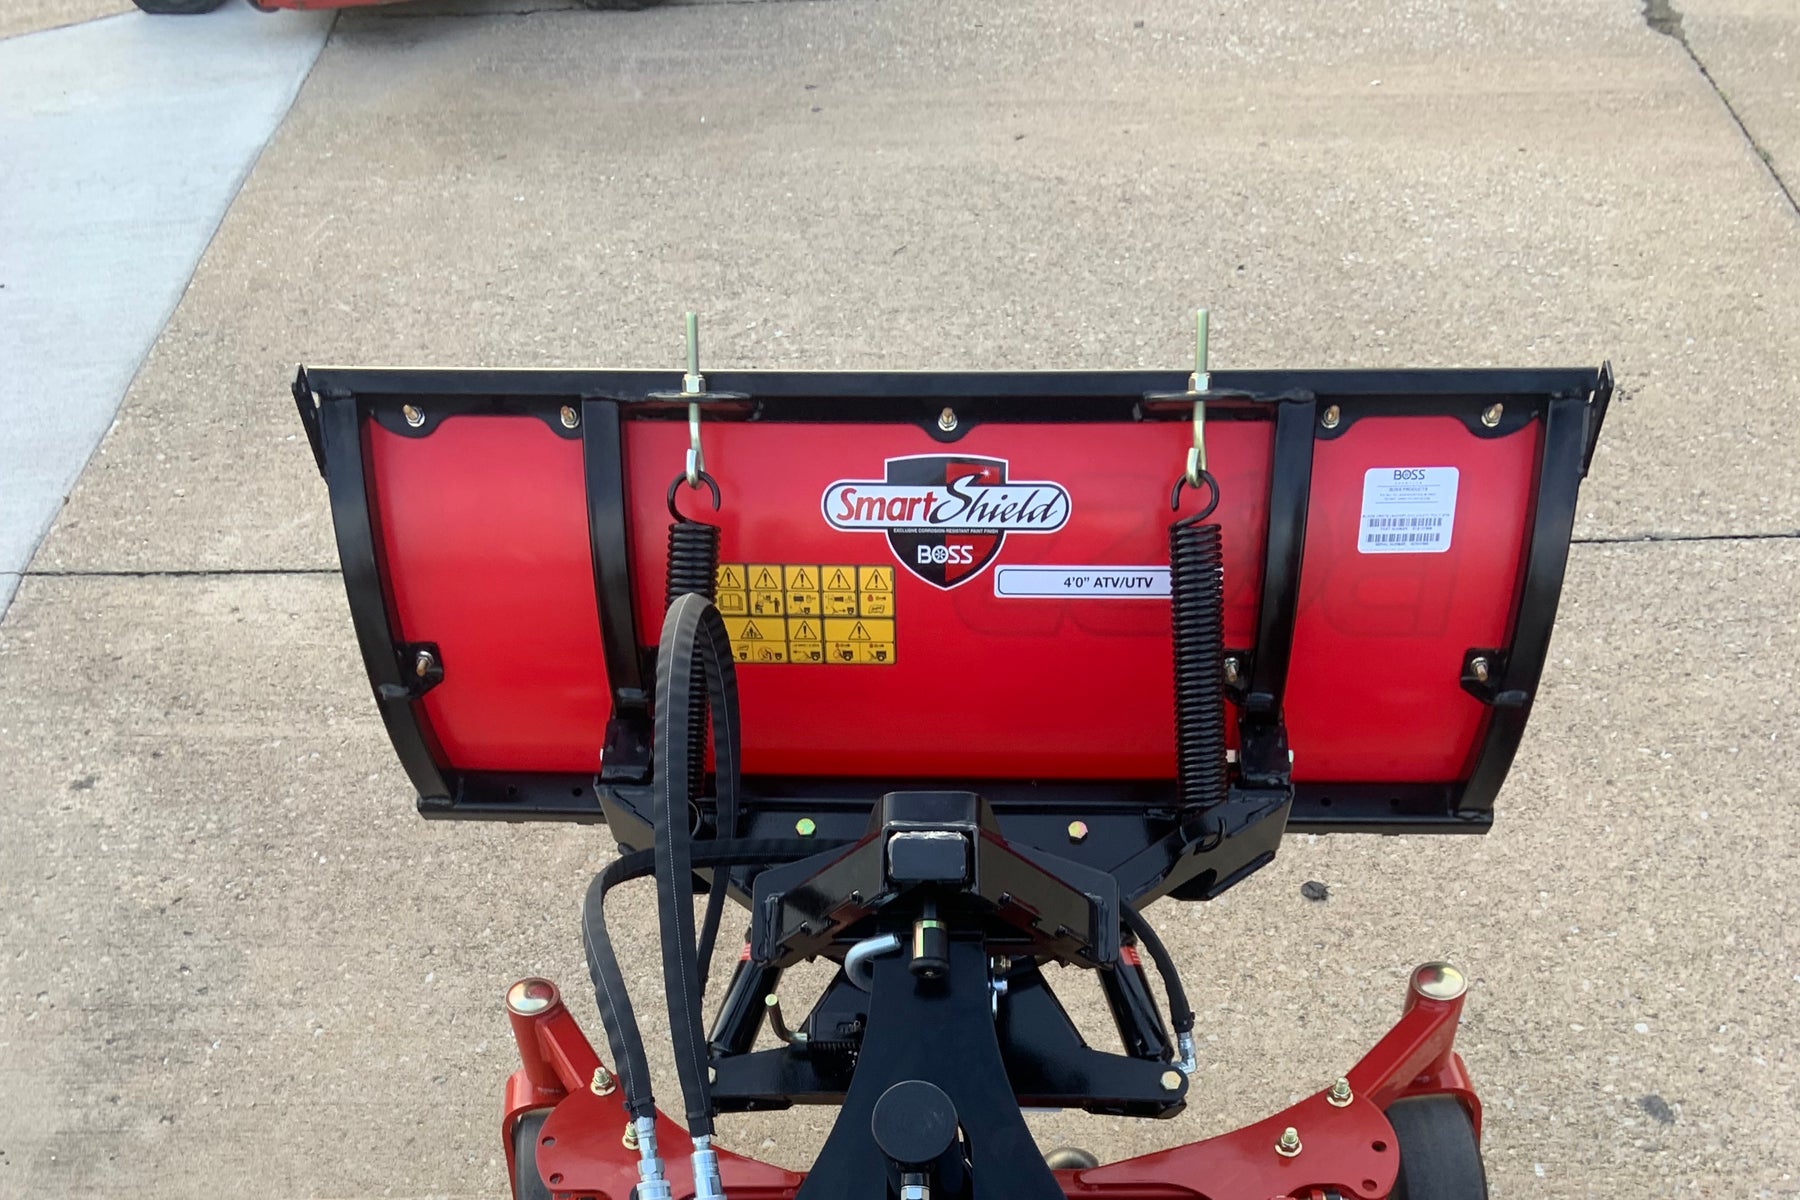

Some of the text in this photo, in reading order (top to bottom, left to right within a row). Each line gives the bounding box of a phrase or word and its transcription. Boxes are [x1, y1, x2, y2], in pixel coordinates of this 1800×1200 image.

[1394, 469, 1426, 480] BOSS
[917, 545, 973, 564] BOSS
[1094, 576, 1154, 588] ATV/UTV
